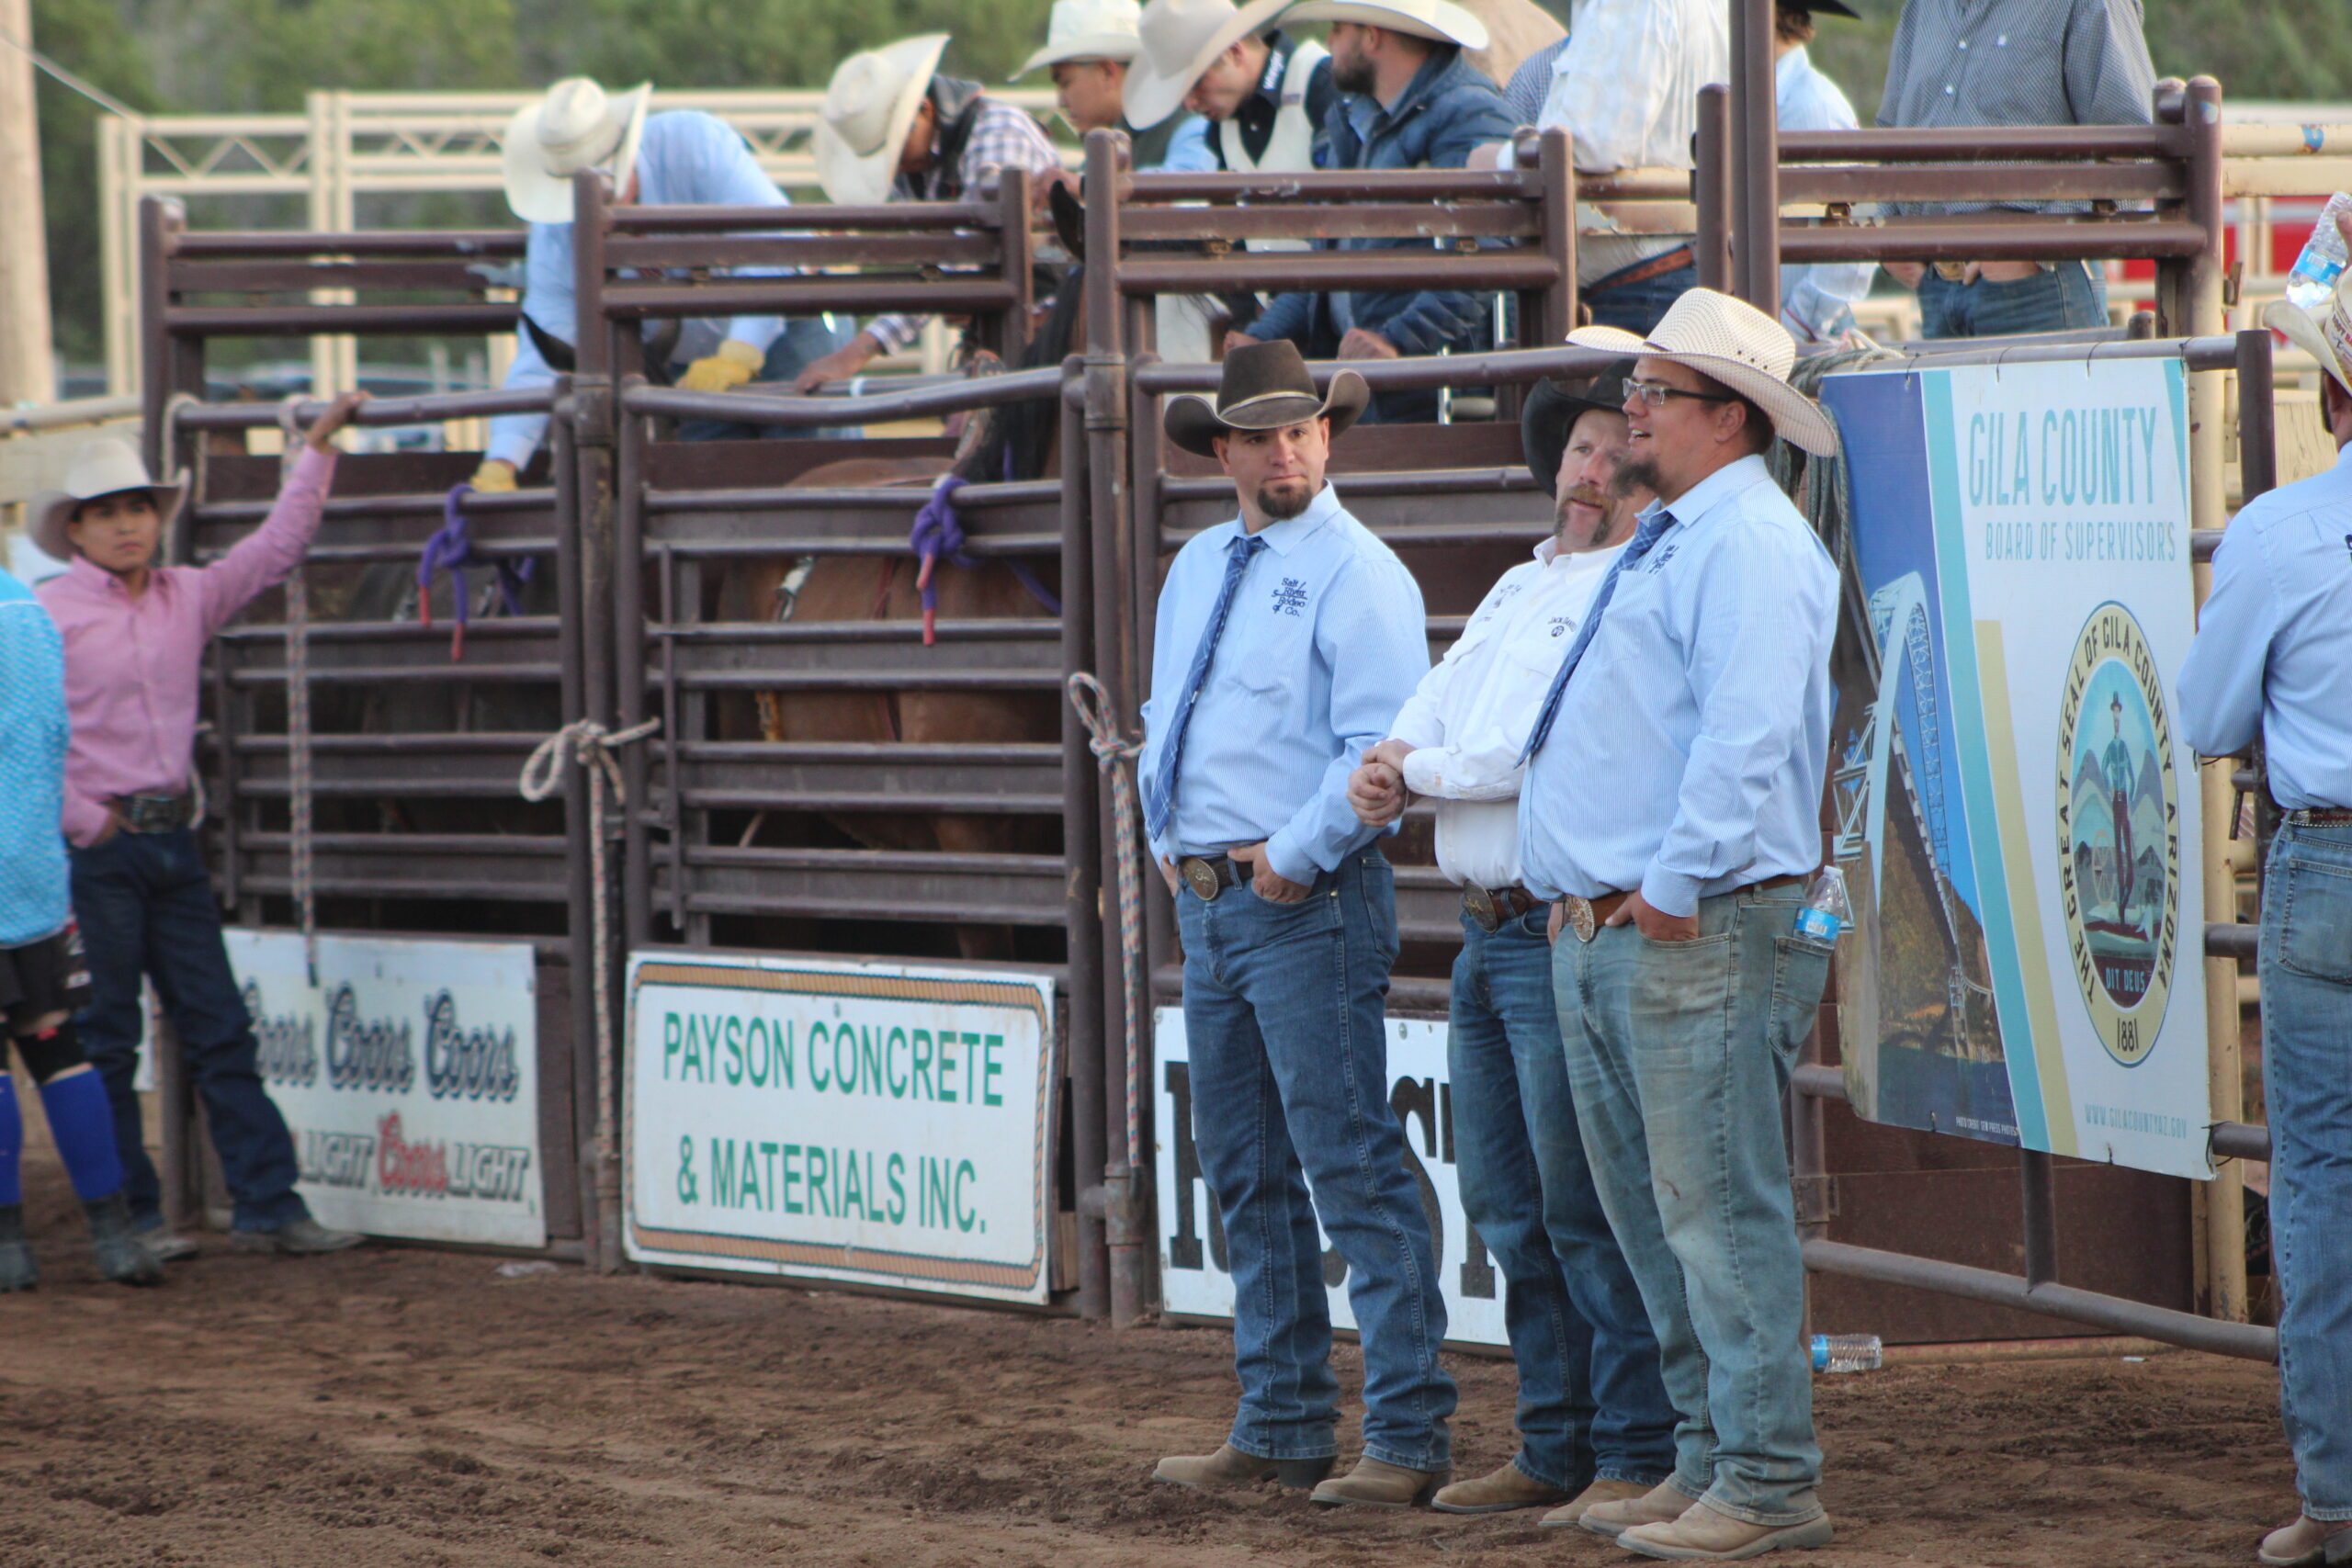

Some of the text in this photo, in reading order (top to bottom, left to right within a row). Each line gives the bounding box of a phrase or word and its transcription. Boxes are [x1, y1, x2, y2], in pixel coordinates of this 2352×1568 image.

[1970, 407, 2156, 506] GILA COUNTY
[1985, 521, 2177, 562] BOARD OF SUPERVISORS
[2059, 615, 2177, 1004] THE GREAT SEAL OF GILA COUNTY ARIZONA
[2123, 969, 2145, 992] DEUS
[243, 976, 521, 1102] oors Coors Coors
[663, 1012, 1004, 1107] PAYSON CONCRETE
[2117, 1017, 2139, 1052] 1881
[300, 1109, 531, 1202] LIGHT Coors LIGHT
[677, 1134, 987, 1235] & MATERIALS INC.
